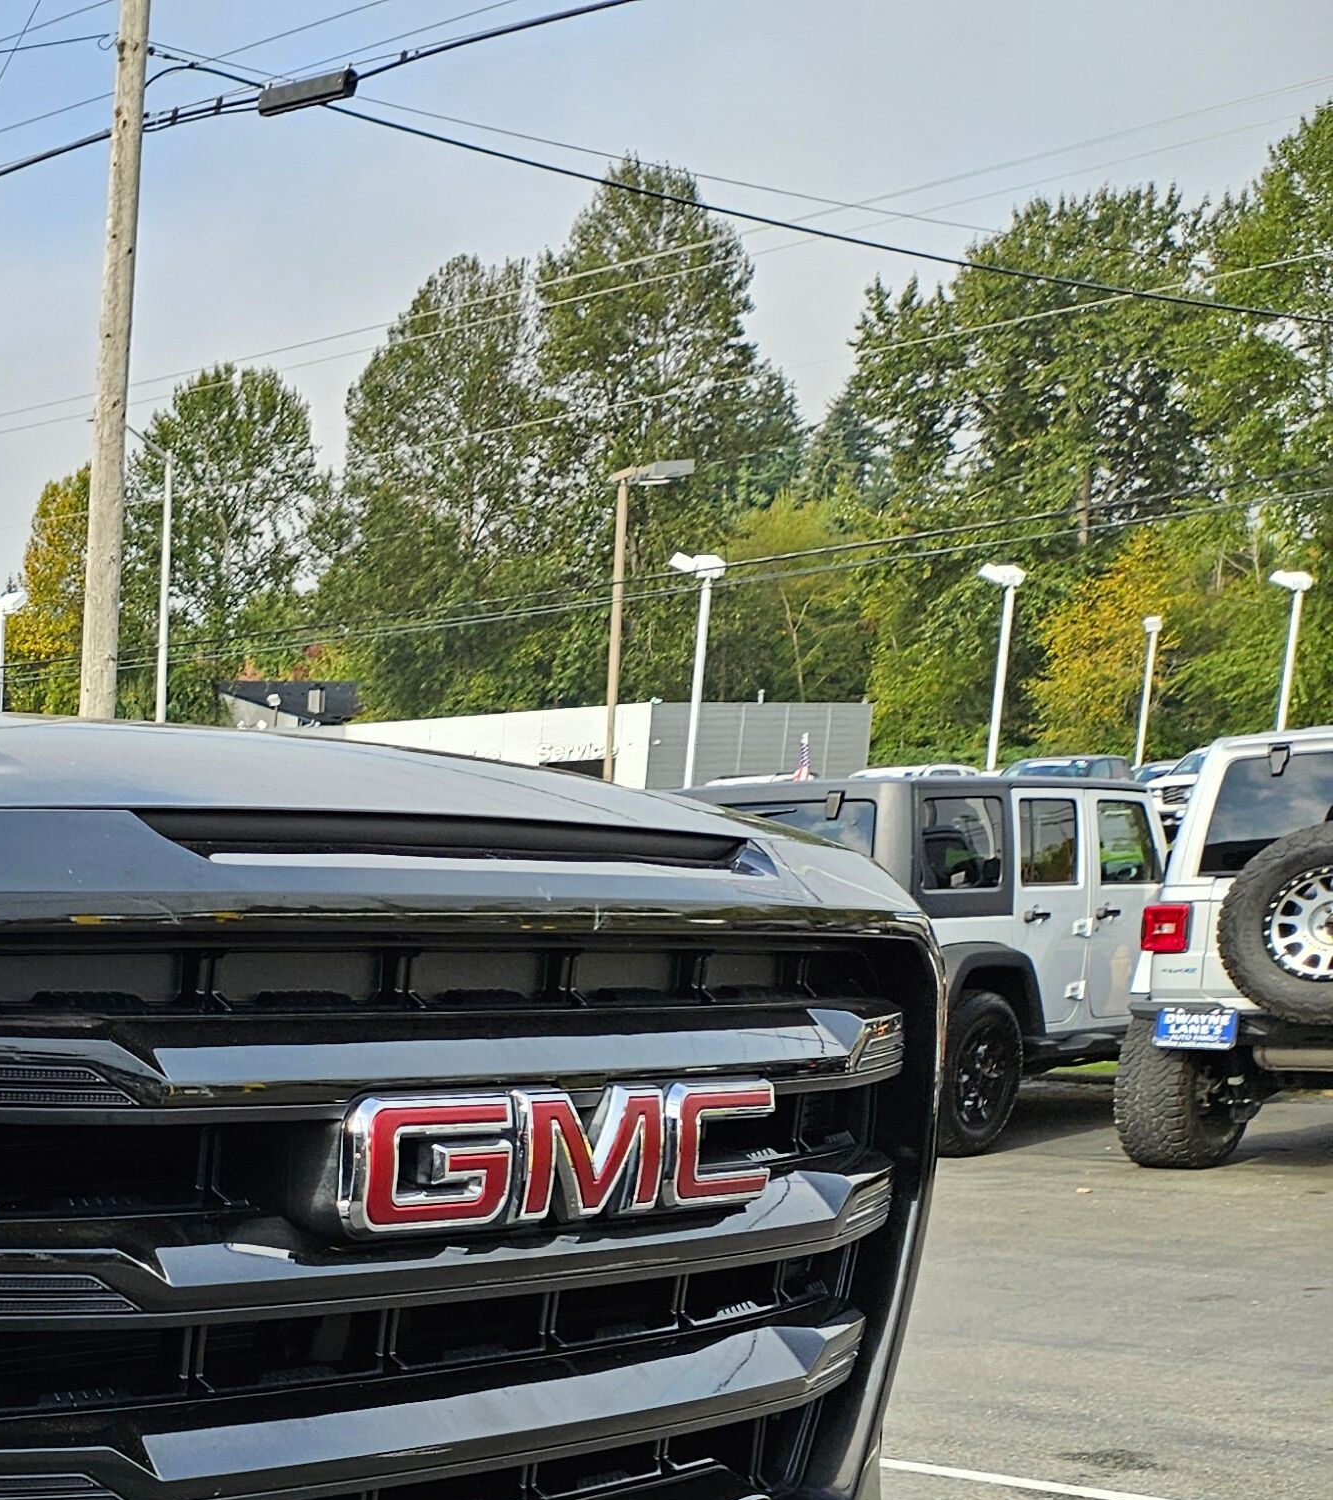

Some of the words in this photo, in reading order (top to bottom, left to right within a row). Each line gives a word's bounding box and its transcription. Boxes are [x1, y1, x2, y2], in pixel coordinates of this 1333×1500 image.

[1163, 1014, 1231, 1026] DWAYNE
[1168, 1024, 1223, 1035] LANE'S
[338, 1081, 775, 1233] GMC
